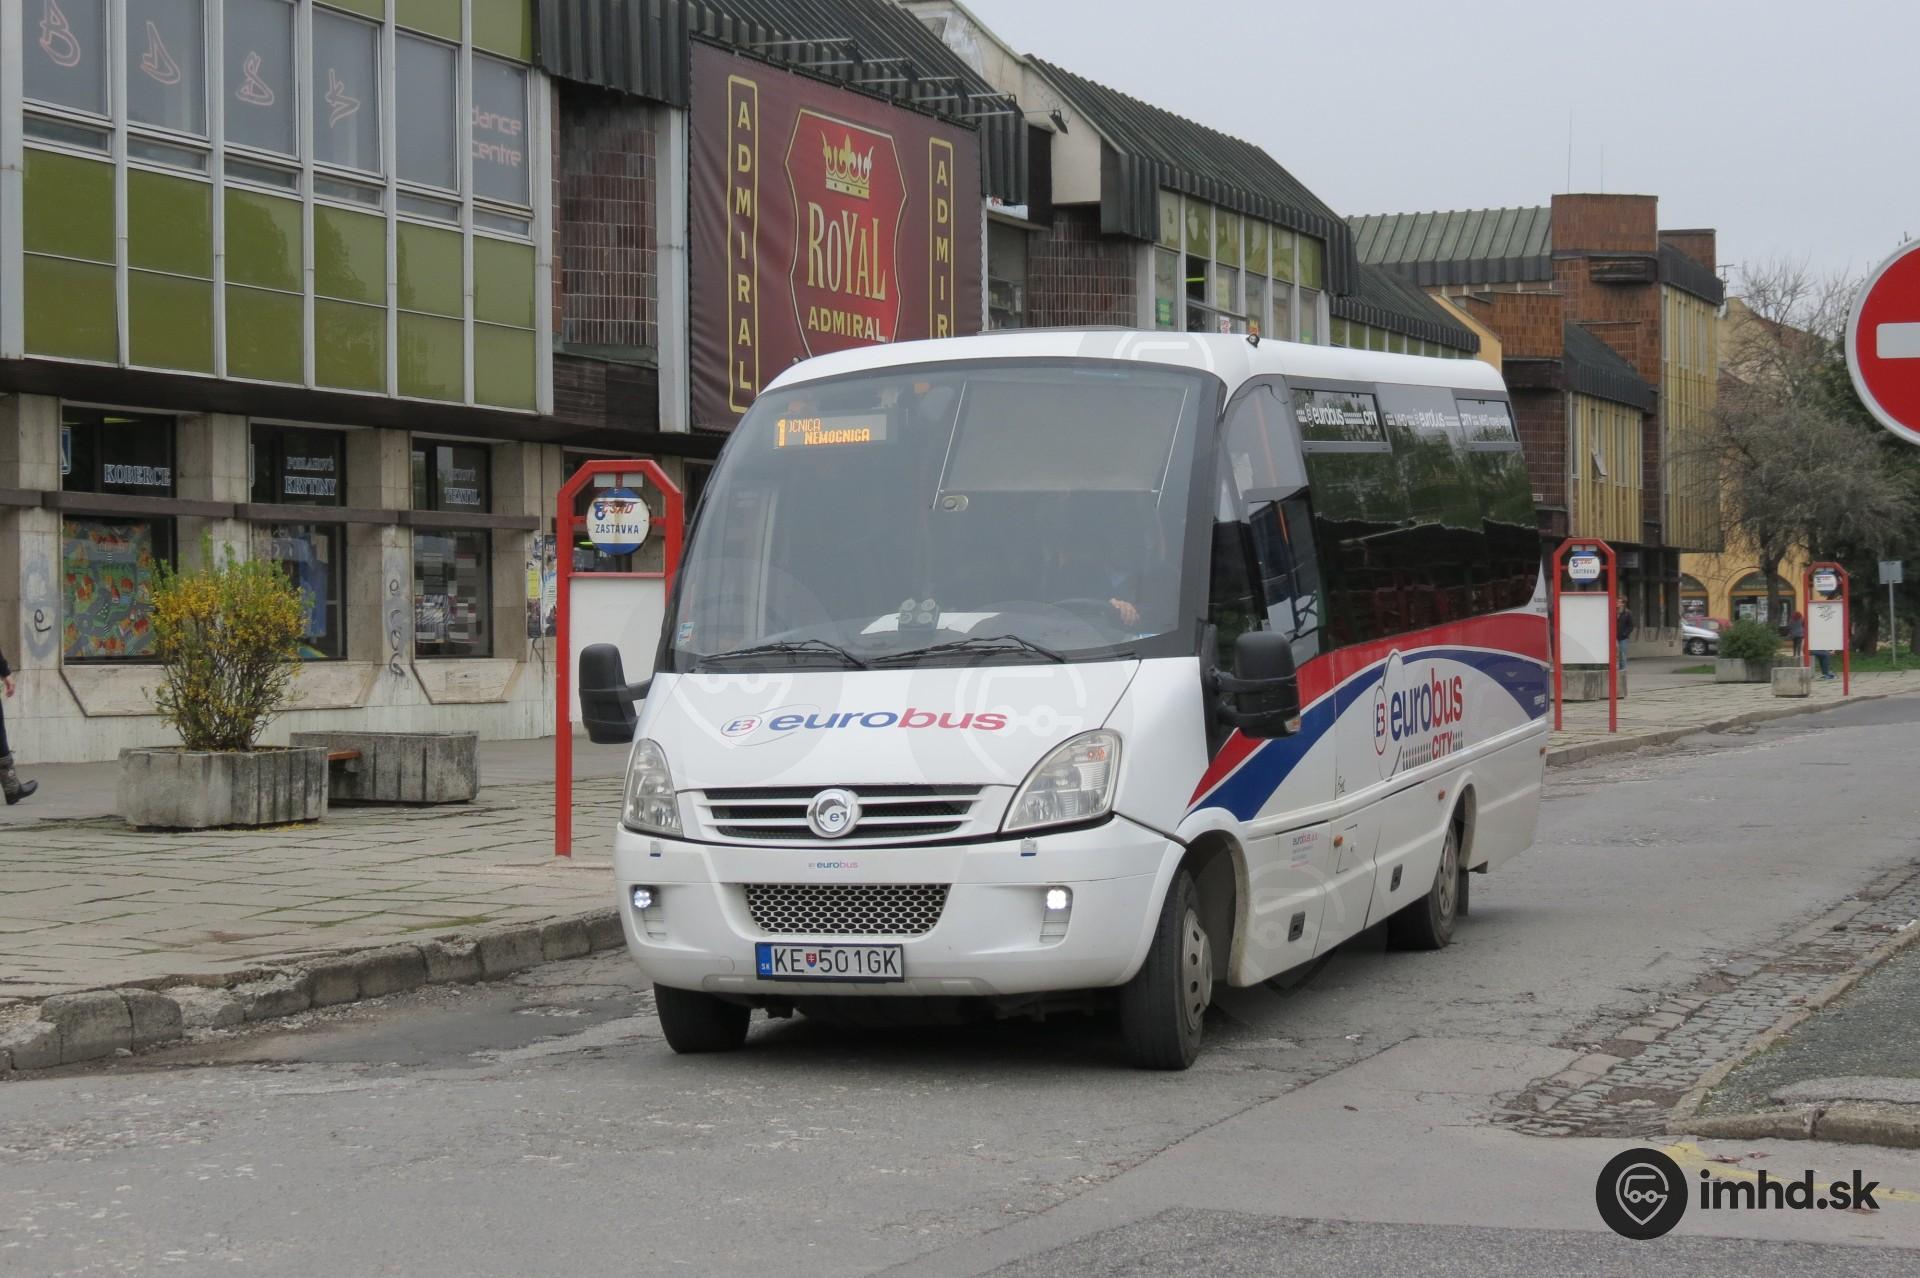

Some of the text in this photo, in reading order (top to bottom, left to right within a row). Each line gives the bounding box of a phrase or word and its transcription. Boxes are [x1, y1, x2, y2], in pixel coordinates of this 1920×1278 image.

[736, 101, 752, 391] ADMIRAL
[807, 201, 887, 301] ROYAL
[807, 306, 884, 344] ADMIRAL
[777, 418, 787, 448] 1
[804, 428, 871, 445] NEMOCNICA
[103, 463, 171, 486] KOBERCE
[284, 475, 337, 496] KRYTINY
[595, 522, 639, 535] ZASTÁVKA
[1390, 667, 1463, 742] eurobus
[768, 707, 1008, 732] eurobus
[1431, 731, 1453, 761] CITY
[816, 860, 859, 870] eurobus
[774, 948, 898, 975] KE 501GK
